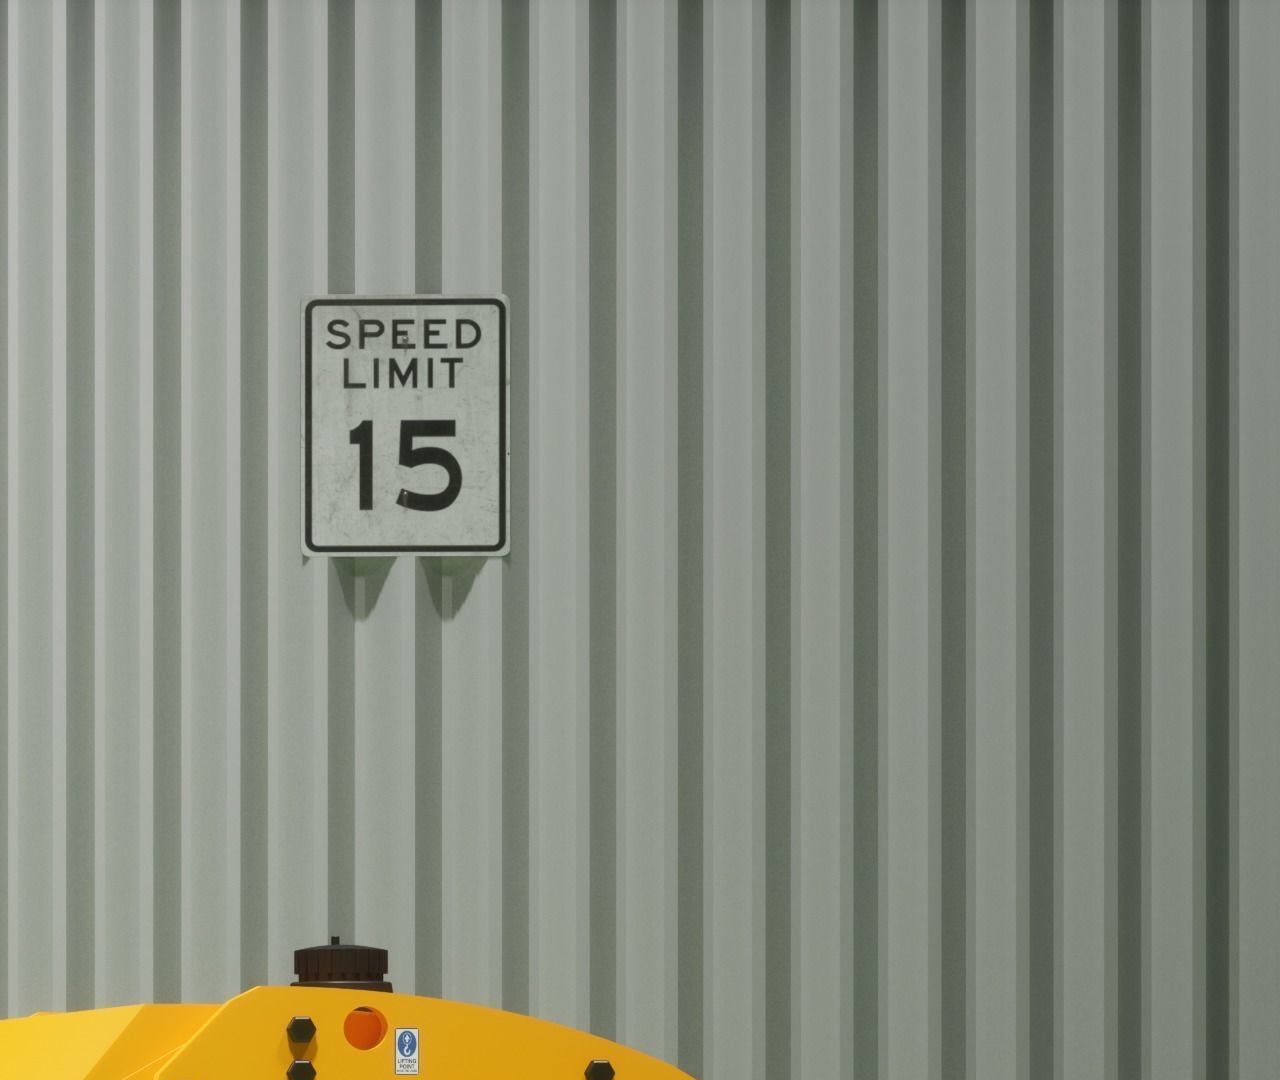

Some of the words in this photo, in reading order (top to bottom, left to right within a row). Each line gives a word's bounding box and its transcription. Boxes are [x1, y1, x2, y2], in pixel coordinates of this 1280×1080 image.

[325, 318, 482, 350] SPEED
[343, 357, 464, 389] LIMIT
[349, 419, 463, 512] 15
